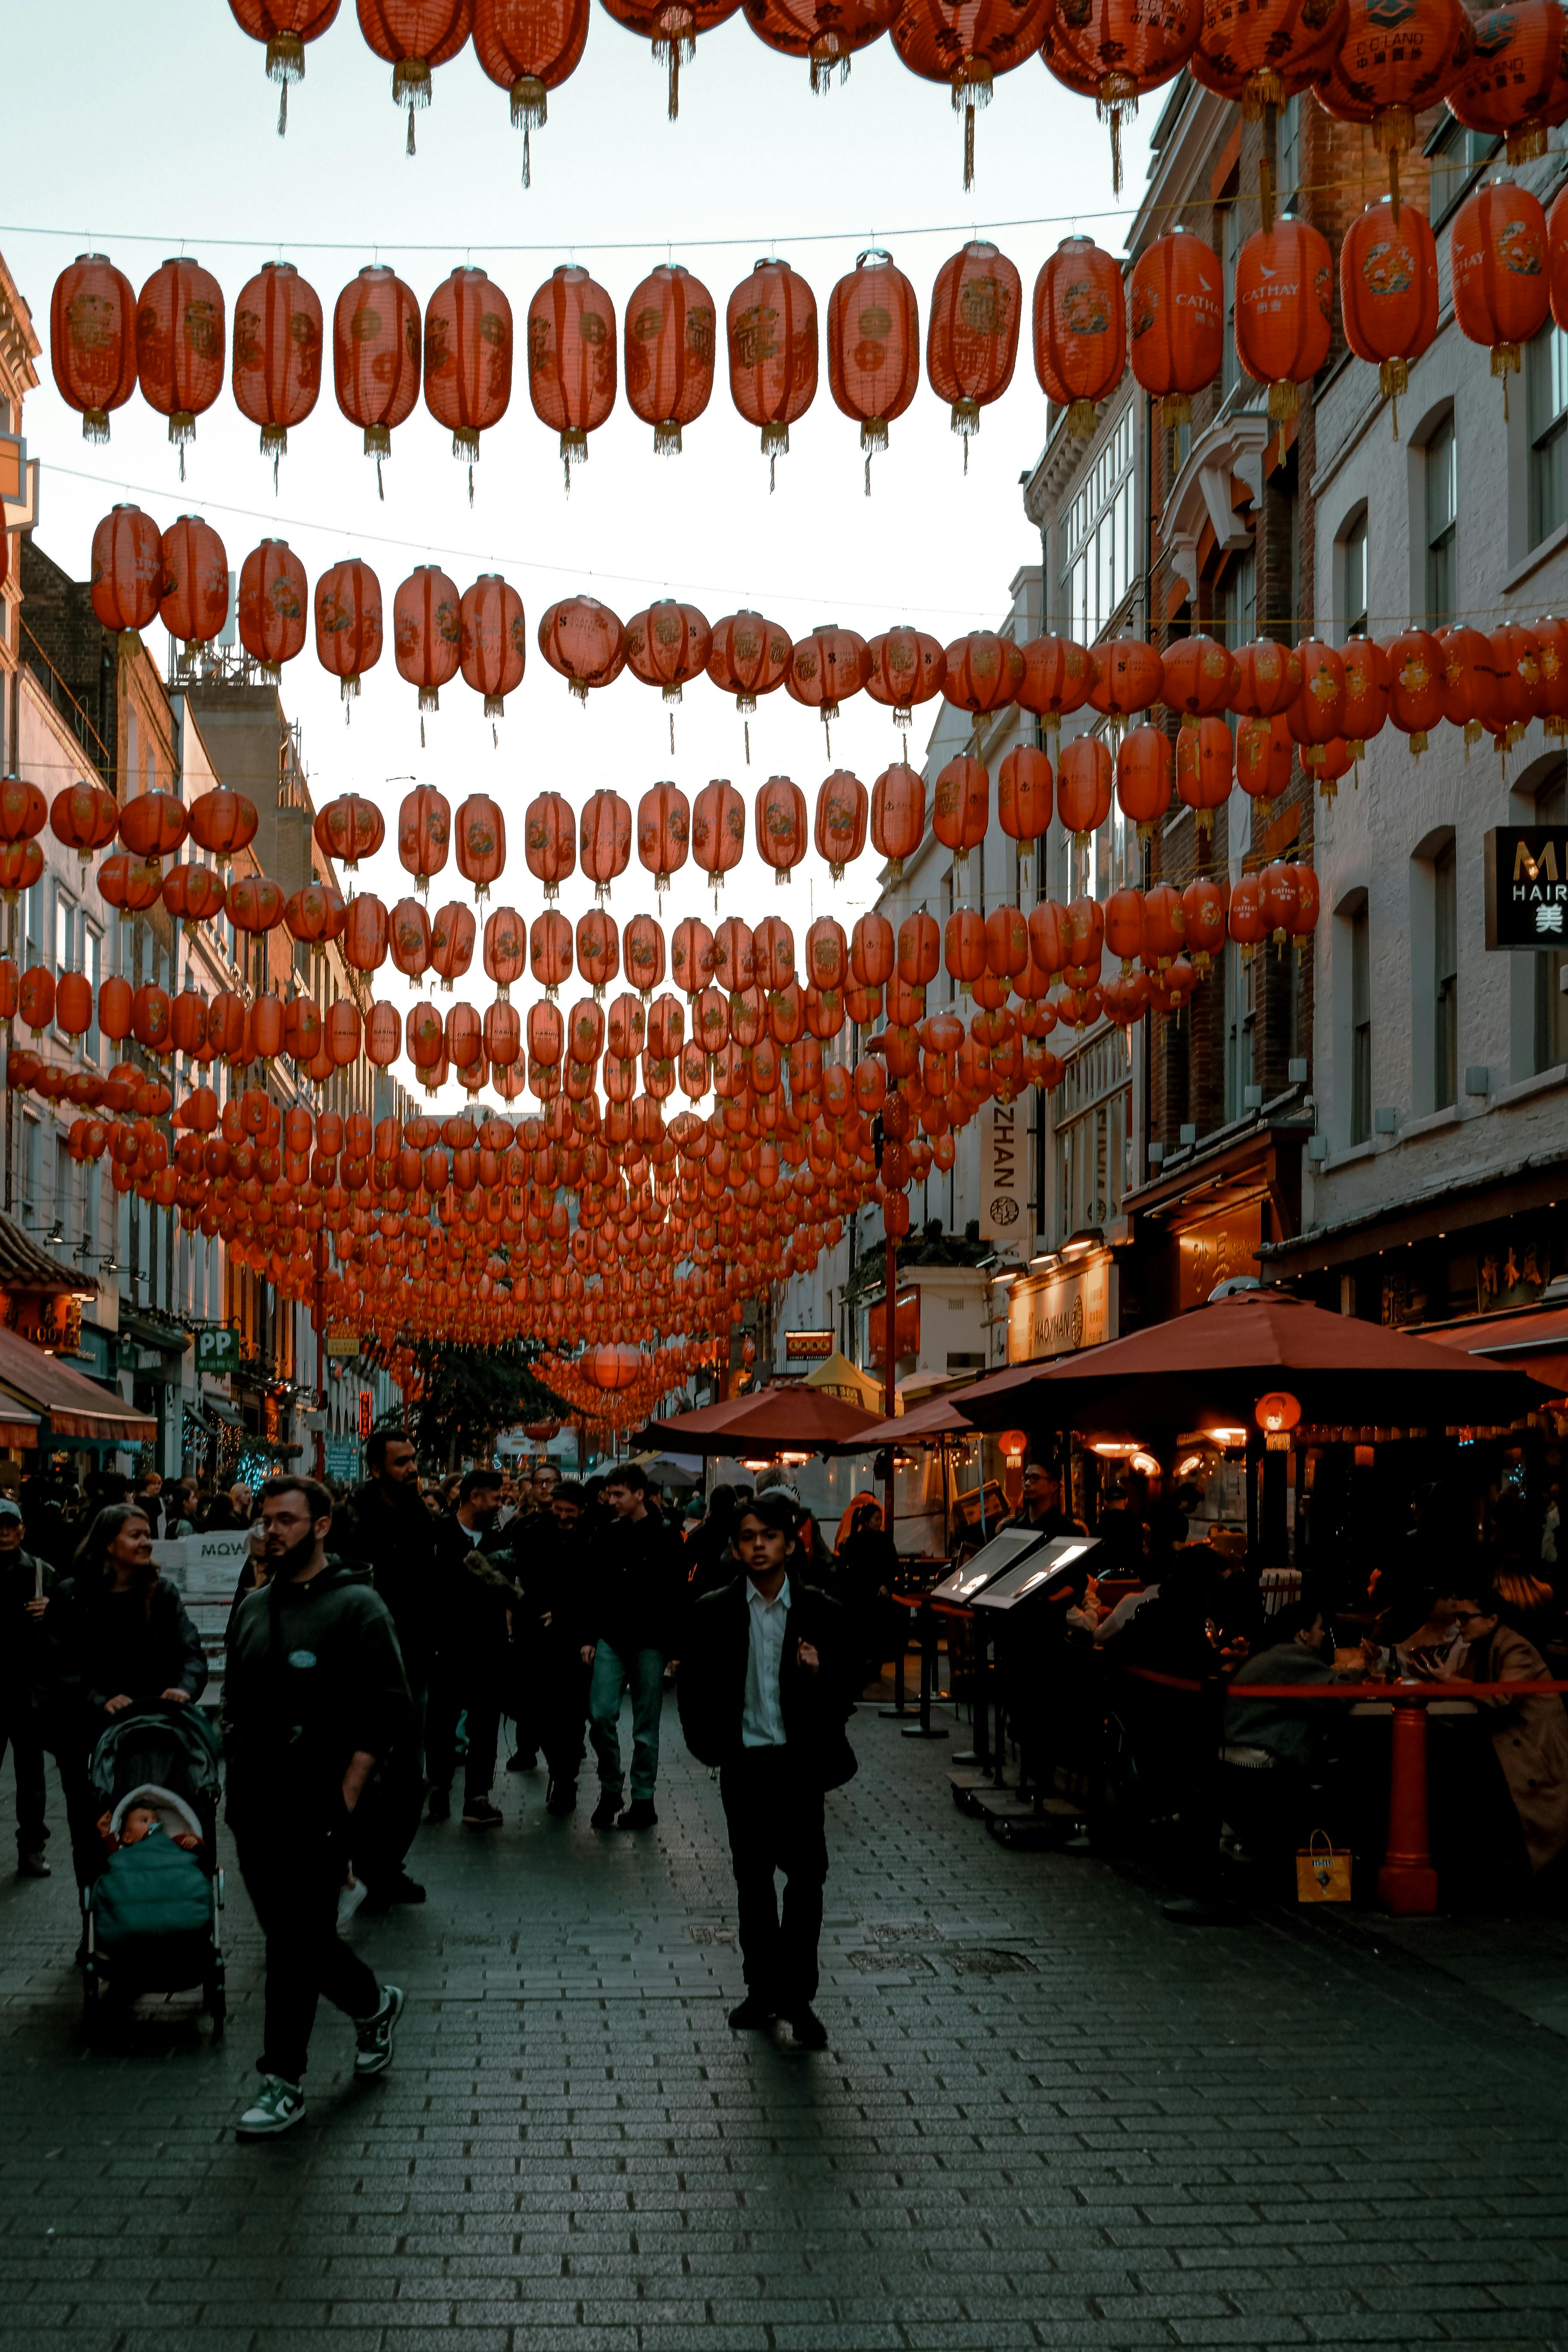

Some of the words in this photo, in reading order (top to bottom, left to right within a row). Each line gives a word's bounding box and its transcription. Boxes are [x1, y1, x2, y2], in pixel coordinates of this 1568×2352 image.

[1384, 33, 1424, 48] LAND
[1486, 58, 1523, 76] LAND
[1242, 283, 1300, 304] CATHAY
[1176, 293, 1222, 317] CATHAY
[1513, 884, 1568, 901] HAIR
[1535, 903, 1563, 933] 美
[1035, 1310, 1070, 1346] HAOZHAN
[200, 1331, 232, 1357] PP
